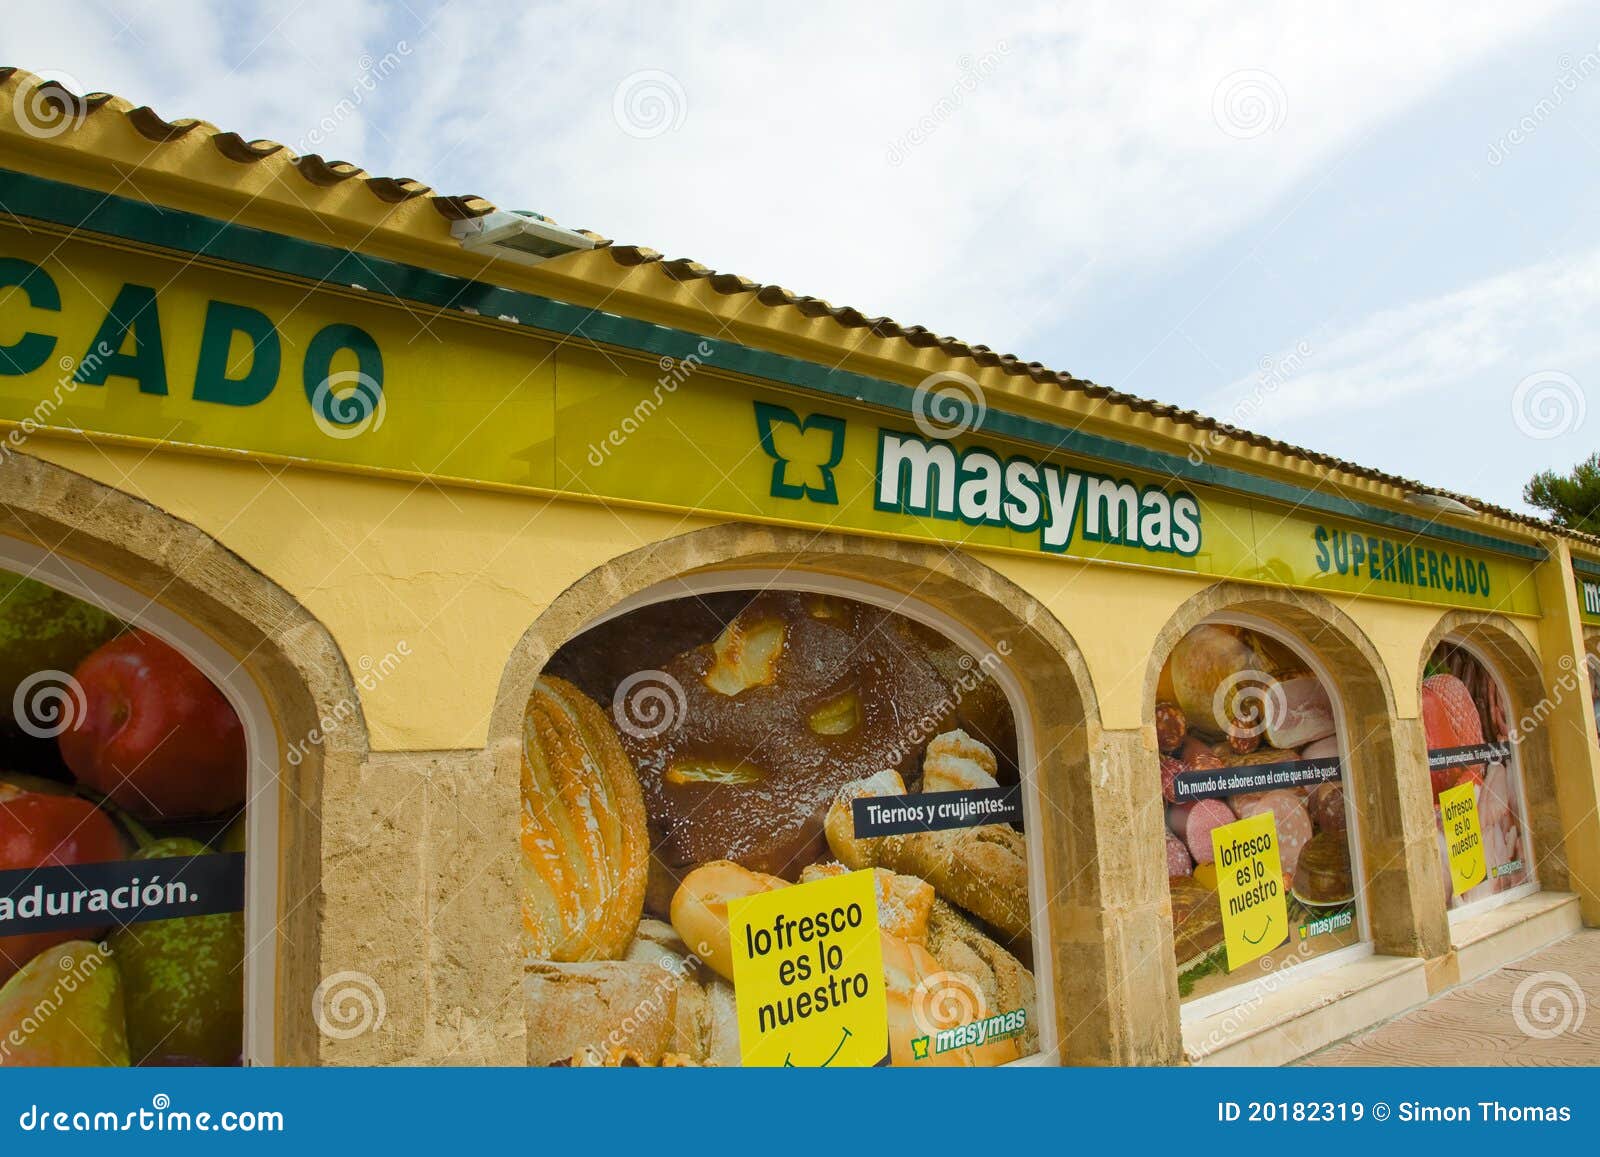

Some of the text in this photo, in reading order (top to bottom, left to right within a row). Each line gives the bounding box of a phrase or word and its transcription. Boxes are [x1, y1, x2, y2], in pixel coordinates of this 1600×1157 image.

[877, 432, 1202, 555] masymas
[1315, 525, 1490, 597] SUPERMERCADO
[1177, 781, 1190, 796] Un
[1190, 777, 1217, 794] mundo
[1217, 775, 1227, 790] de
[1227, 773, 1254, 789] sabores
[1254, 773, 1267, 785] con
[1267, 770, 1273, 784] el
[1274, 770, 1290, 783] corte
[1290, 771, 1302, 785] que
[1302, 766, 1315, 780] más
[1314, 766, 1321, 779] te
[866, 797, 1015, 825] Tiernos y crujientes...
[1451, 832, 1479, 858] nuestro
[1236, 858, 1265, 887] es lo
[0, 875, 199, 921] aduración.
[1229, 879, 1278, 916] nuestro
[1309, 911, 1352, 937] masymas
[778, 940, 844, 986] es lo
[757, 971, 869, 1034] nuestro
[935, 1008, 1026, 1054] masymas
